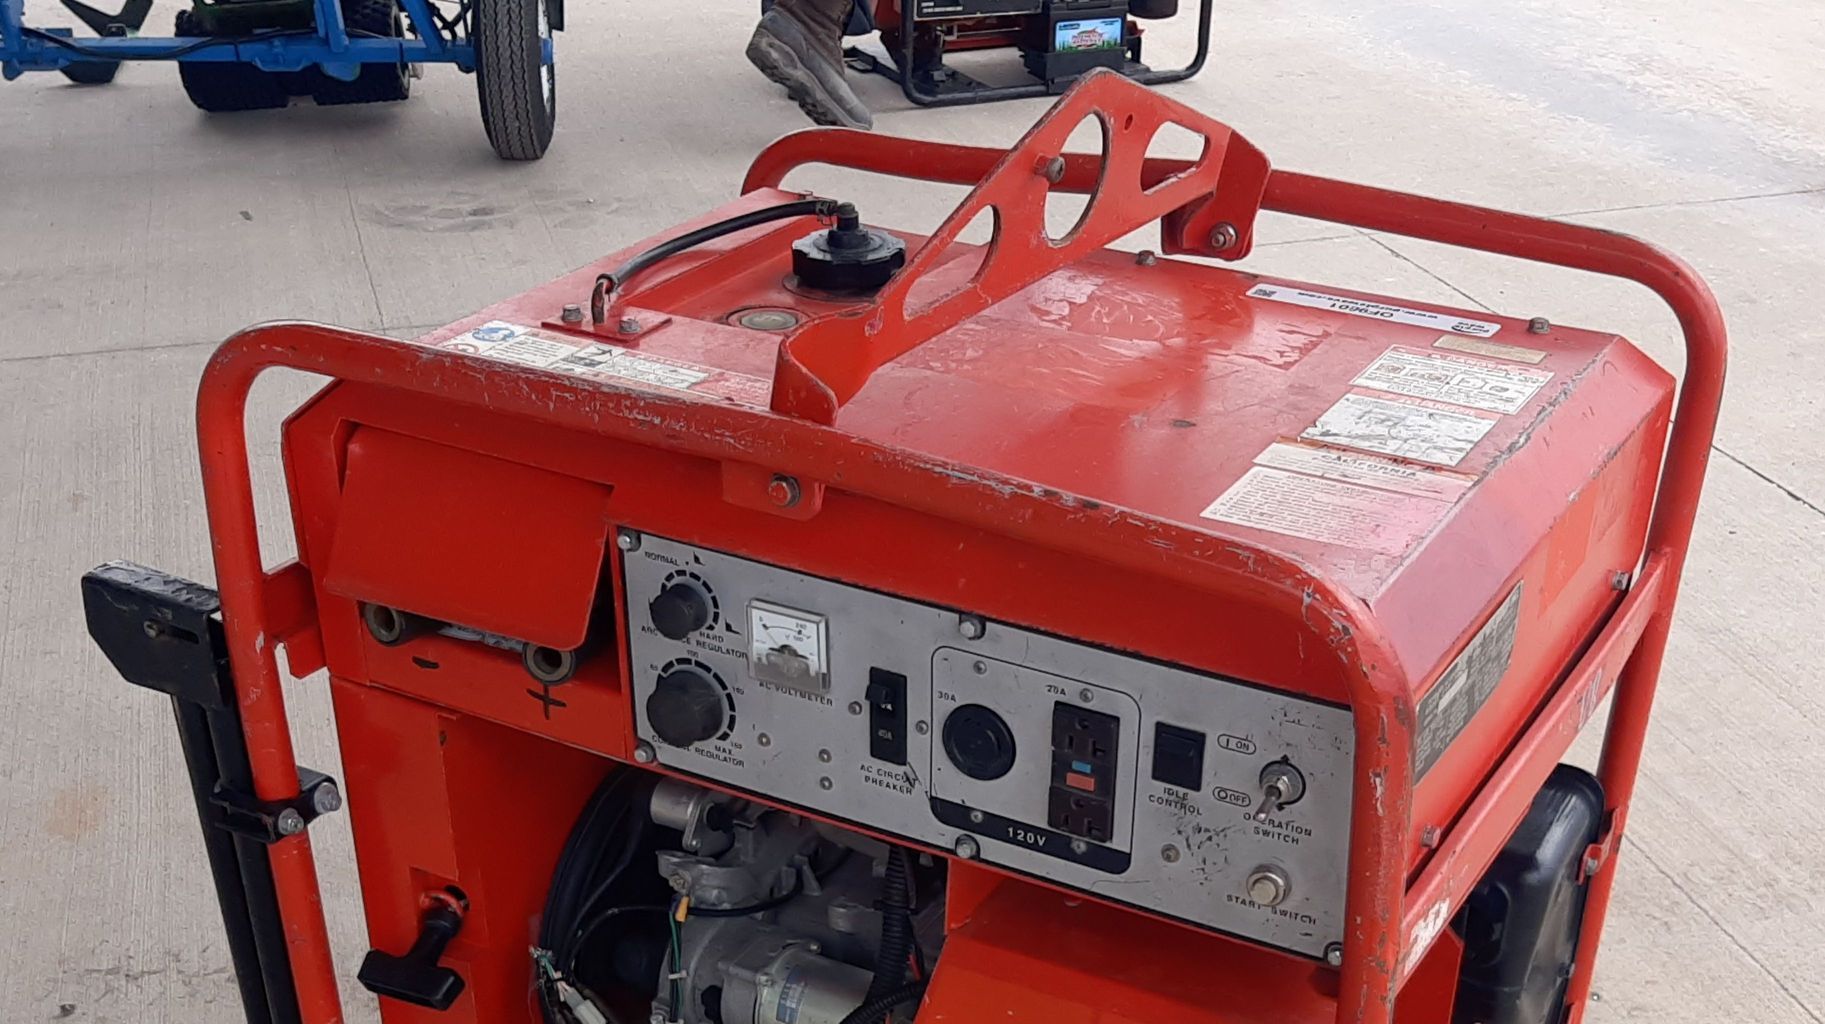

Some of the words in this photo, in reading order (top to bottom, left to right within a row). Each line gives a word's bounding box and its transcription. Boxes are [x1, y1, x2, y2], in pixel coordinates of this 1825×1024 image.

[645, 551, 680, 567] NORMAL
[699, 631, 724, 643] HARD
[695, 639, 748, 659] REGULATOR
[775, 684, 833, 706] VOLTMETER
[937, 690, 956, 702] 30A
[1046, 685, 1067, 696] 20A
[1235, 740, 1250, 751] ON
[695, 747, 745, 768] REGULATOR
[860, 764, 873, 773] AC
[864, 775, 912, 795] BREAKER
[1163, 787, 1189, 800] IDLE
[1148, 794, 1202, 815] CONTROL
[1229, 794, 1247, 804] OFF
[1243, 812, 1312, 836] ORATION
[1008, 827, 1046, 846] 120V
[1253, 826, 1299, 845] SWITCH
[1226, 894, 1261, 909] START
[1271, 906, 1316, 925] SWITCH
